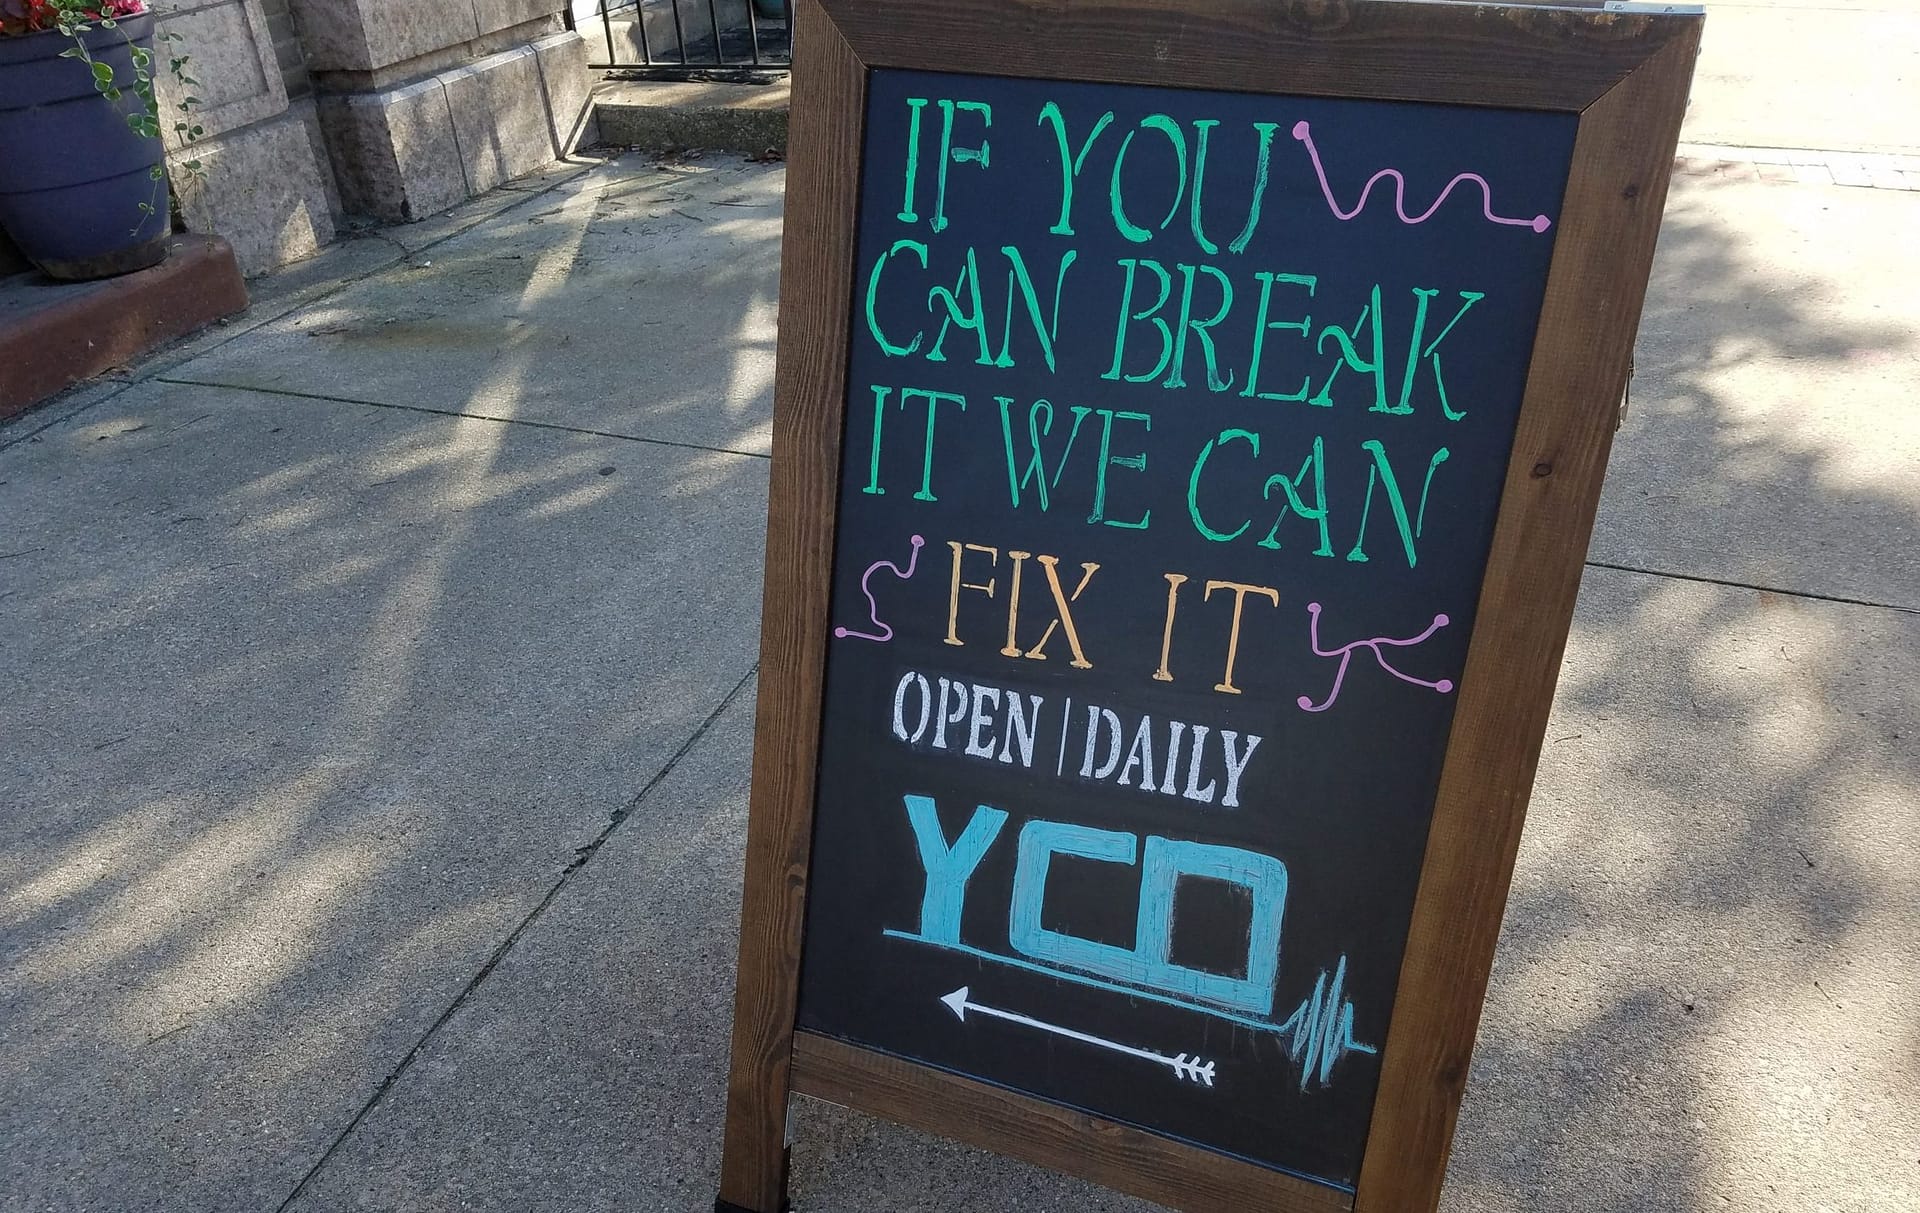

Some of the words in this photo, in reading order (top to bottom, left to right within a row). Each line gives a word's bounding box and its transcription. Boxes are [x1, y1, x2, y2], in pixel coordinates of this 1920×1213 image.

[896, 97, 992, 234] IF
[1037, 101, 1281, 255] YOU
[865, 239, 1077, 375] CAN
[1100, 258, 1485, 422] BREAK
[862, 384, 967, 502] IT
[993, 396, 1151, 530] WE
[1187, 428, 1450, 569] CAN
[943, 540, 1100, 670] FIX
[1152, 573, 1280, 695] IT
[892, 670, 1045, 768] OPEN
[1078, 705, 1263, 809] DAILY
